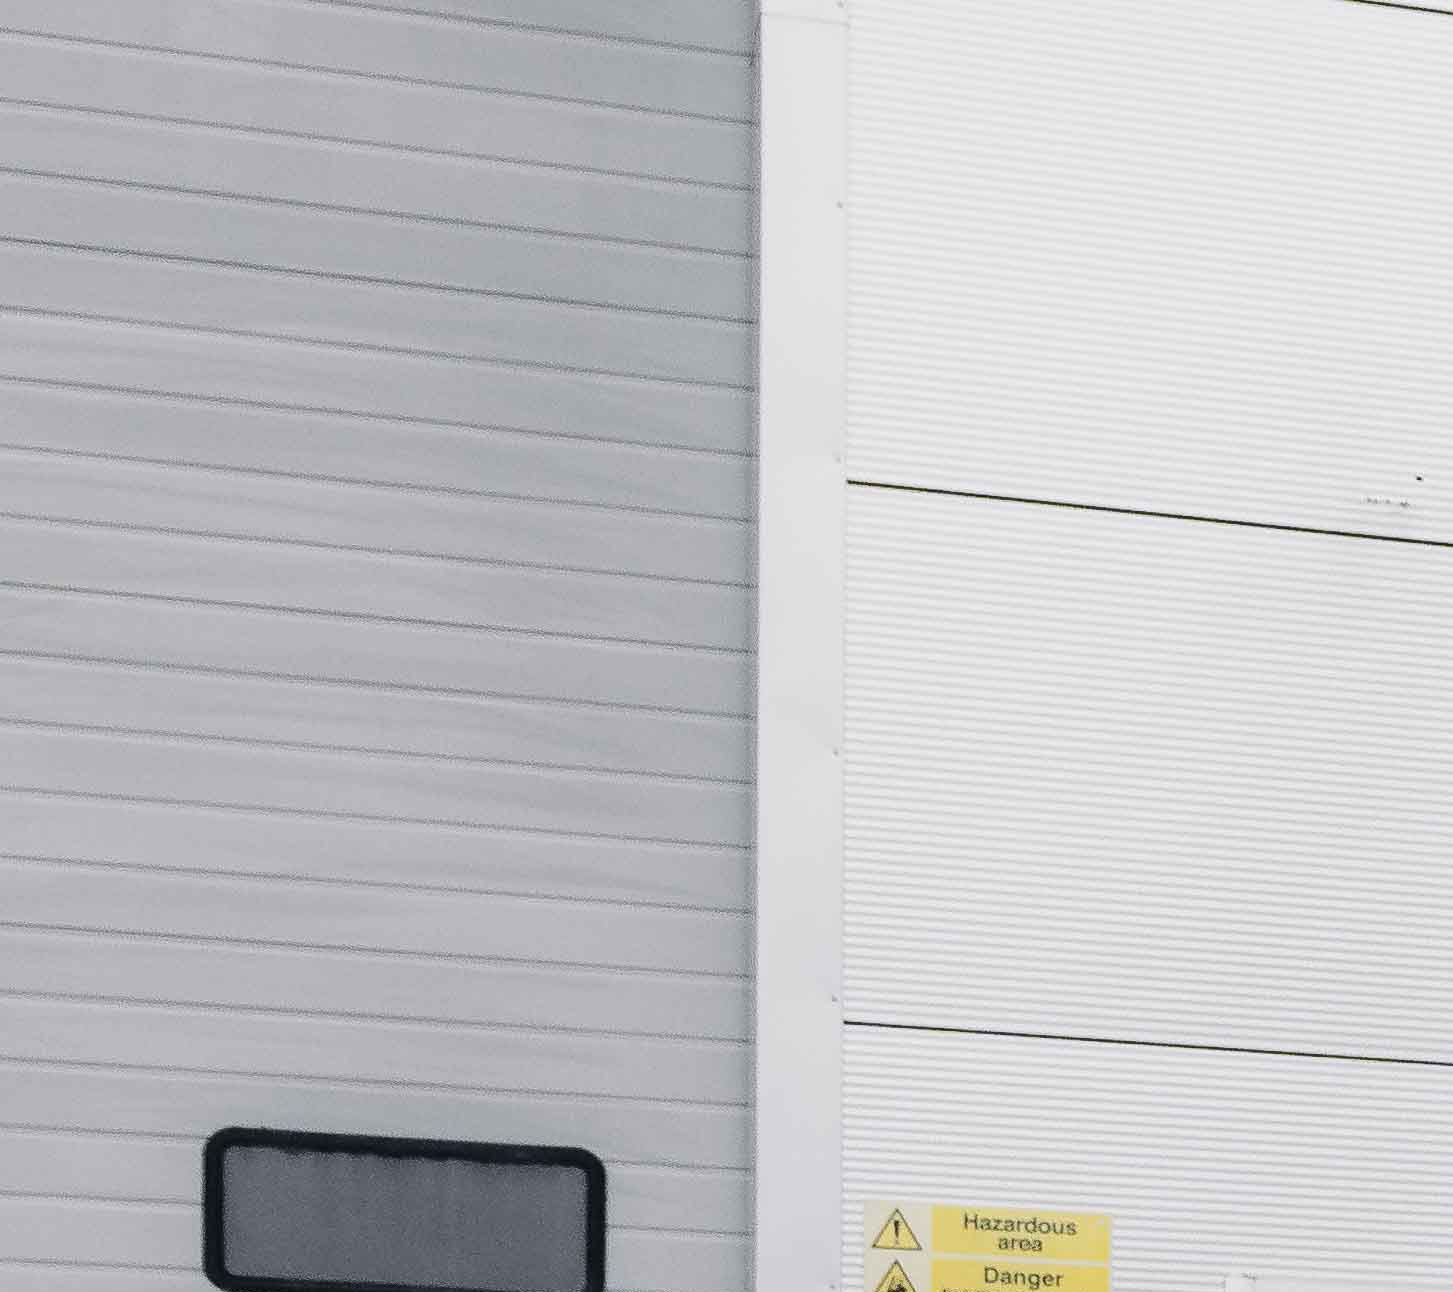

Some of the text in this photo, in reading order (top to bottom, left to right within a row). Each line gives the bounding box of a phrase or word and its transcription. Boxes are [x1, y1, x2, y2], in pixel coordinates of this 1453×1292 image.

[963, 1212, 1078, 1236] Hazardous
[998, 1237, 1043, 1252] area
[984, 1265, 1064, 1290] Danger
